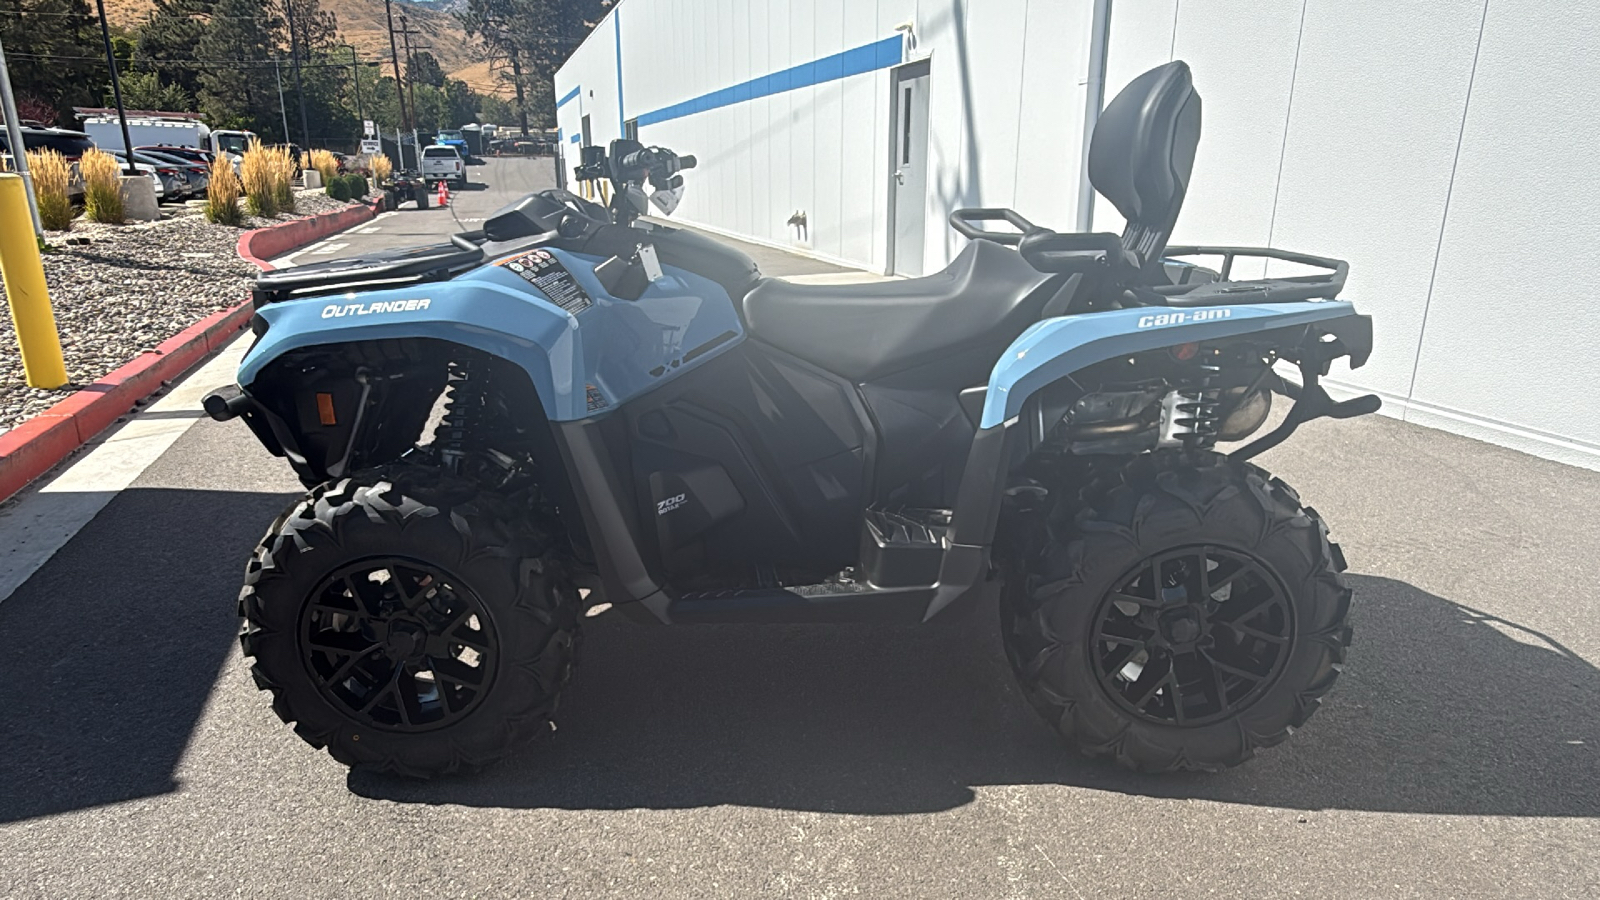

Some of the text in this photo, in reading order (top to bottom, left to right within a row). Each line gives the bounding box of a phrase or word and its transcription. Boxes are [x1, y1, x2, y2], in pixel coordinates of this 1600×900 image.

[321, 298, 431, 319] OUTLANDER
[1138, 308, 1231, 328] can-am
[657, 493, 685, 510] 700
